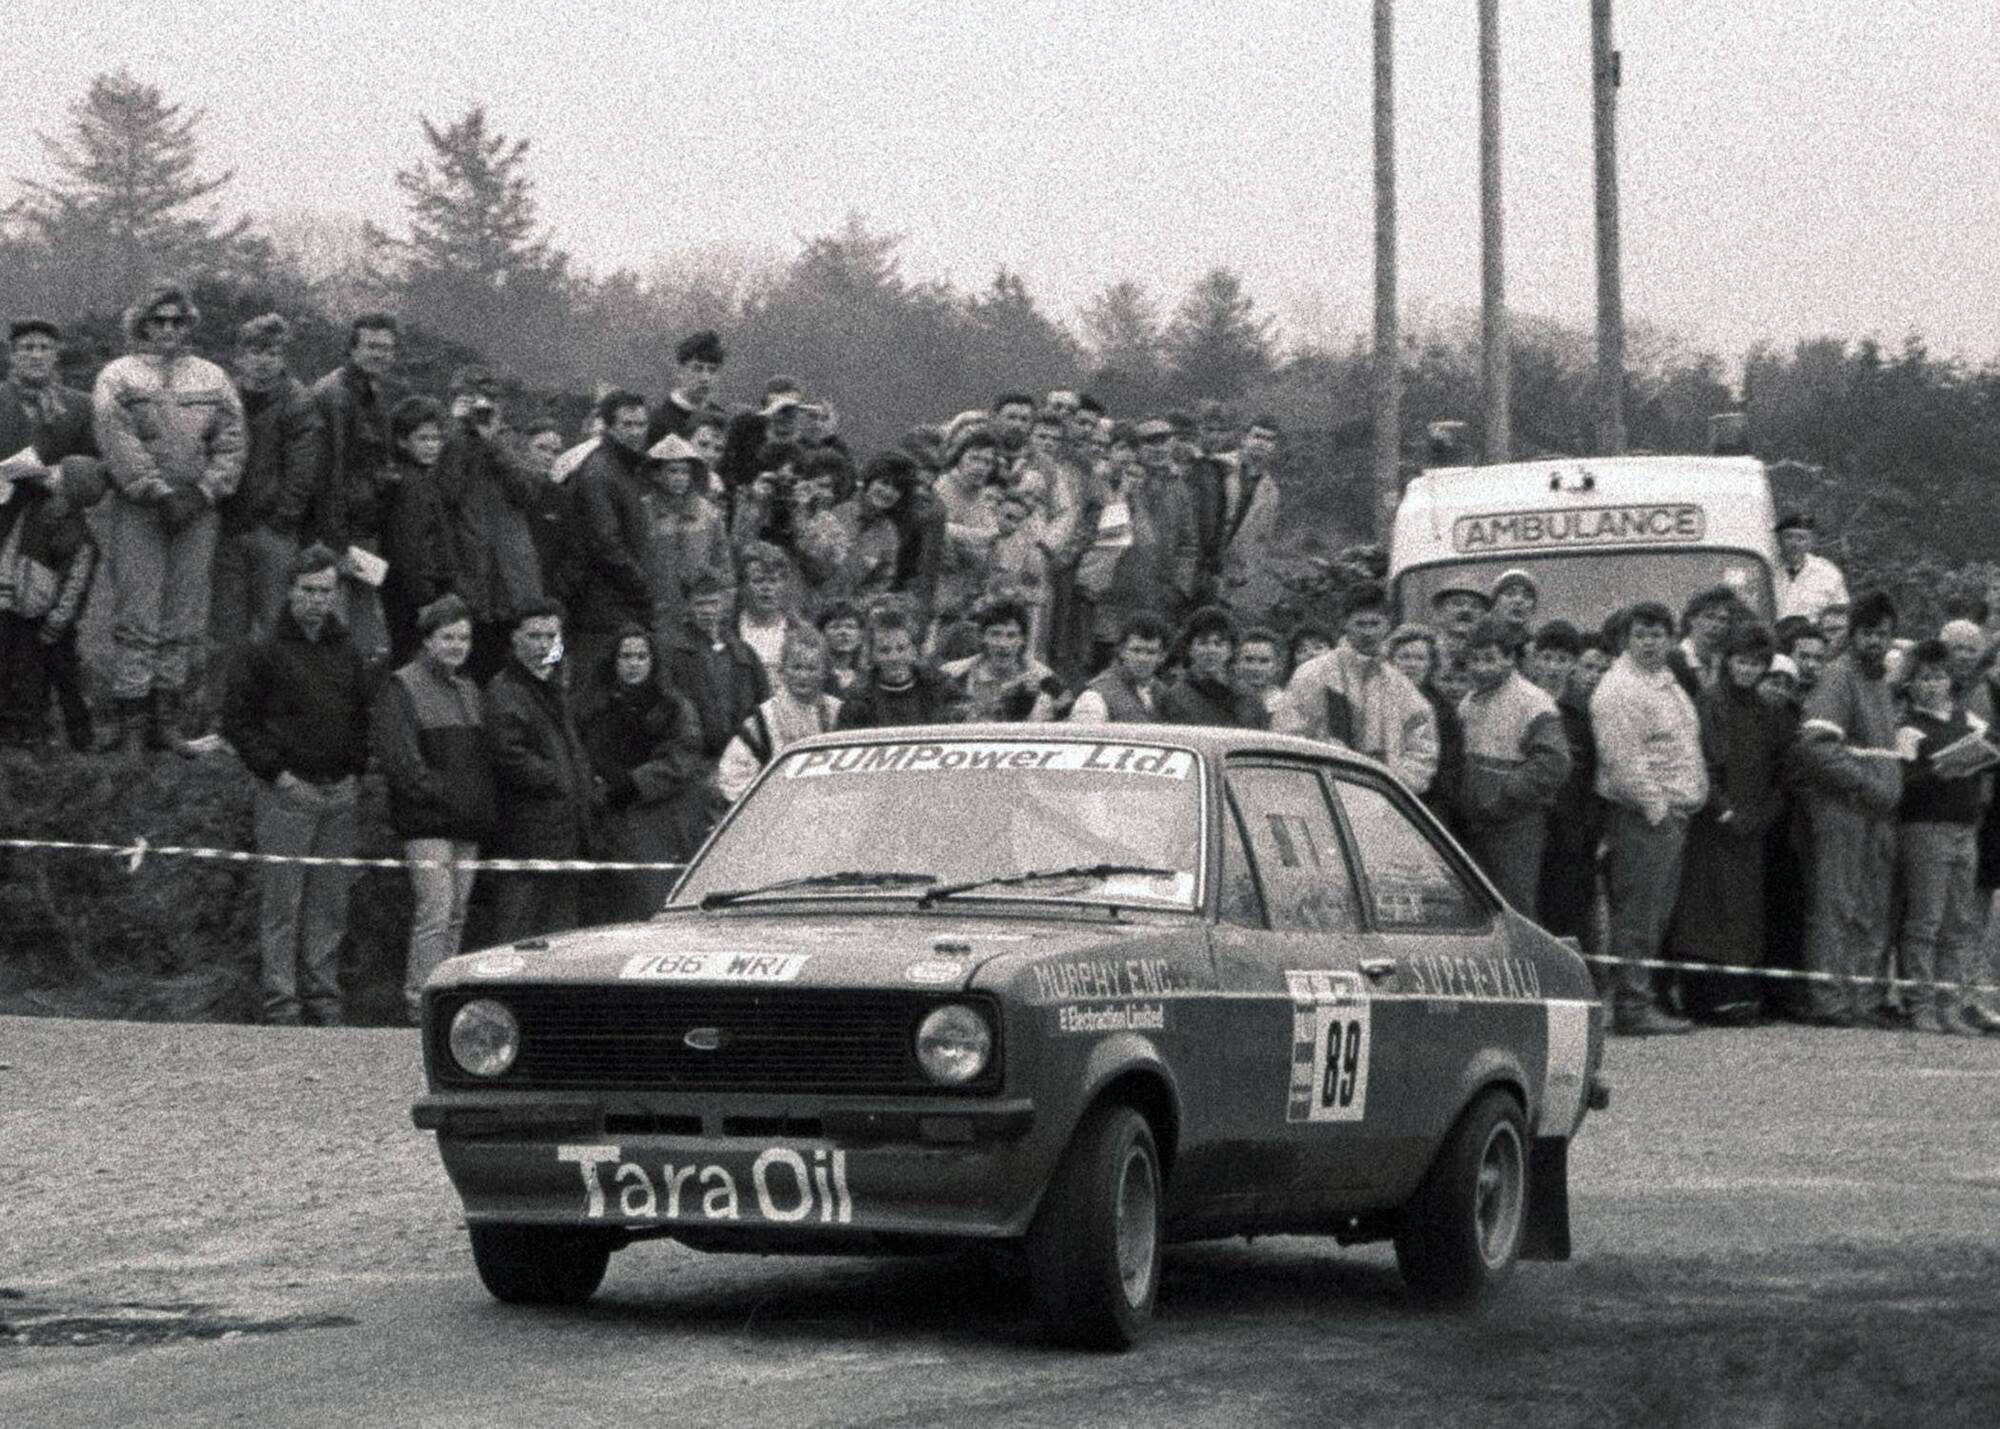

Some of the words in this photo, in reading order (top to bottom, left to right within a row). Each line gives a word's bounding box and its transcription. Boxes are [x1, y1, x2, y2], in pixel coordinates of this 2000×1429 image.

[1465, 508, 1697, 547] AMBULANCE
[1080, 745, 1177, 777] Ltd.
[1033, 960, 1122, 999] MURPHY
[1322, 1020, 1361, 1107] 89
[557, 1145, 740, 1218] Tara
[752, 1147, 851, 1223] Oil
